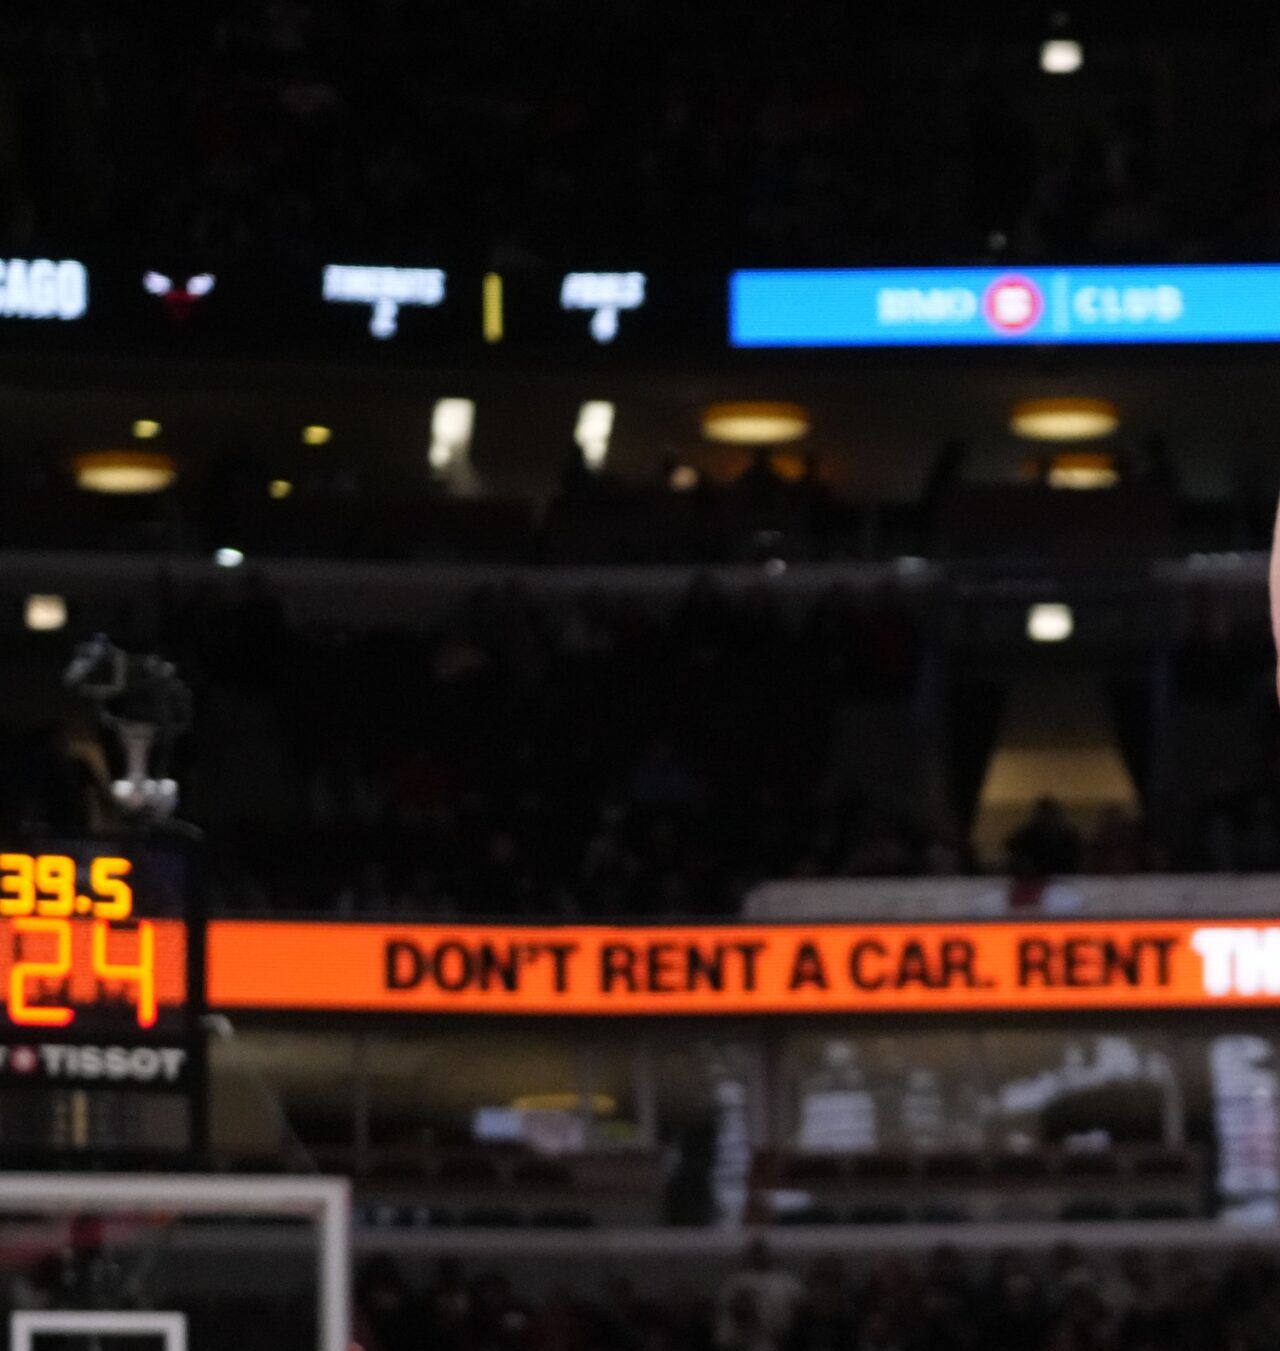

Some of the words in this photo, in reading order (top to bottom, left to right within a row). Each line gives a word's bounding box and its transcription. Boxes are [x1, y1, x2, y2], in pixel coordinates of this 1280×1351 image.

[0, 258, 88, 320] AGO
[8, 916, 157, 1028] 24
[384, 938, 578, 994] DON'T
[601, 939, 766, 994] RENT
[787, 939, 829, 991] A
[850, 937, 994, 991] CAR.
[1016, 935, 1178, 989] RENT
[41, 1044, 186, 1081] TISSOT
